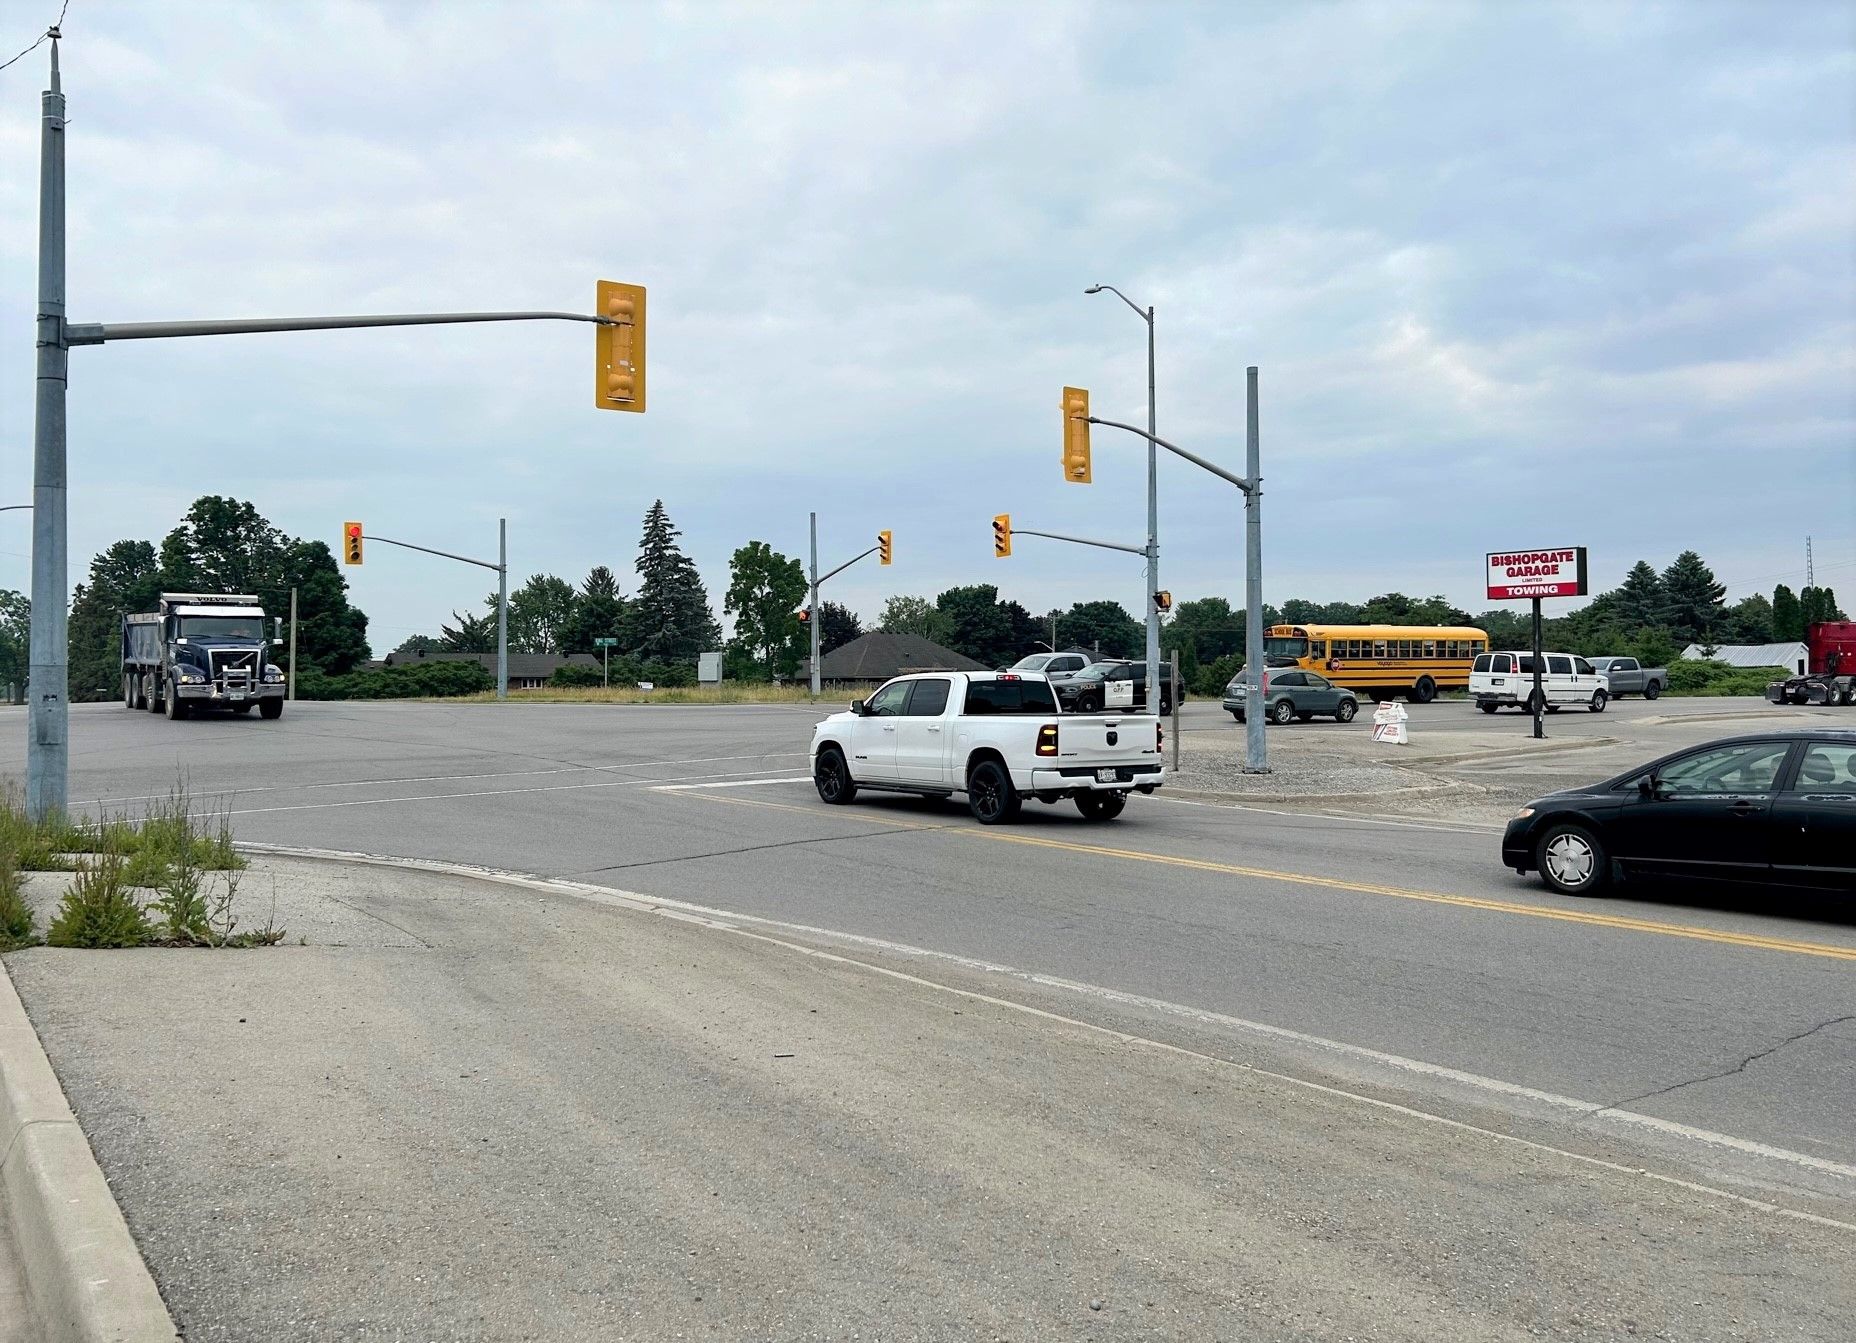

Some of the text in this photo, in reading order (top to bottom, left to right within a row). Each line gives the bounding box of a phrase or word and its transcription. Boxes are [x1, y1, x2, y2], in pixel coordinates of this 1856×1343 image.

[1492, 551, 1573, 566] BISHOPGATE
[1506, 565, 1559, 577] GARAGE
[1507, 585, 1558, 595] TOWING
